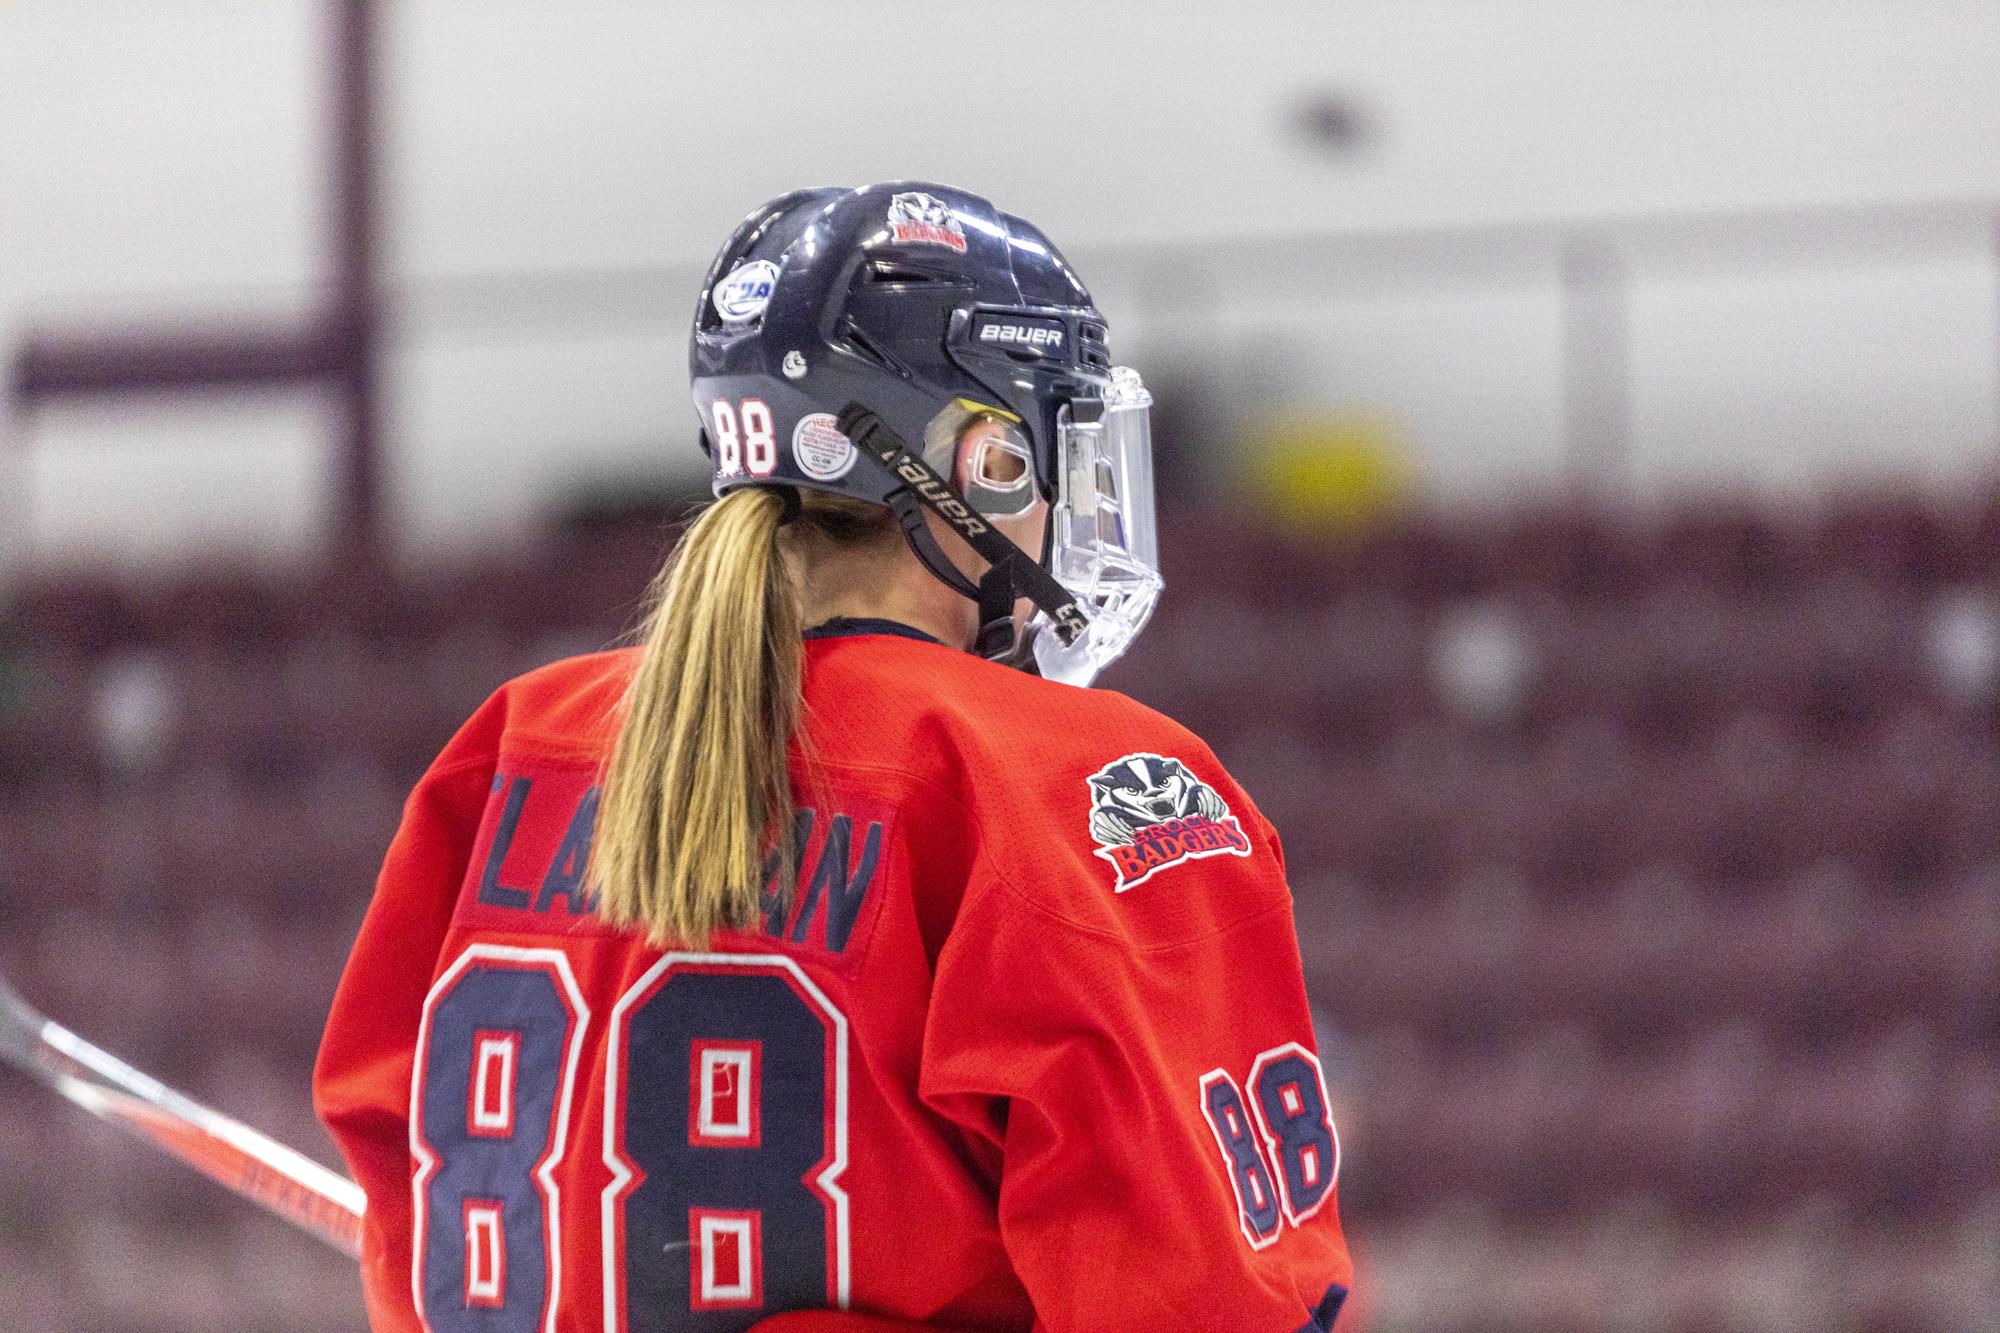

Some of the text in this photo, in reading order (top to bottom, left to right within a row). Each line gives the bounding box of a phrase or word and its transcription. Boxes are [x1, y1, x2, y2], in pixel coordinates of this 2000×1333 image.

[712, 397, 778, 478] 88
[1108, 819, 1249, 881] BADGERS
[409, 943, 849, 1333] 88
[1199, 1041, 1341, 1251] 88
